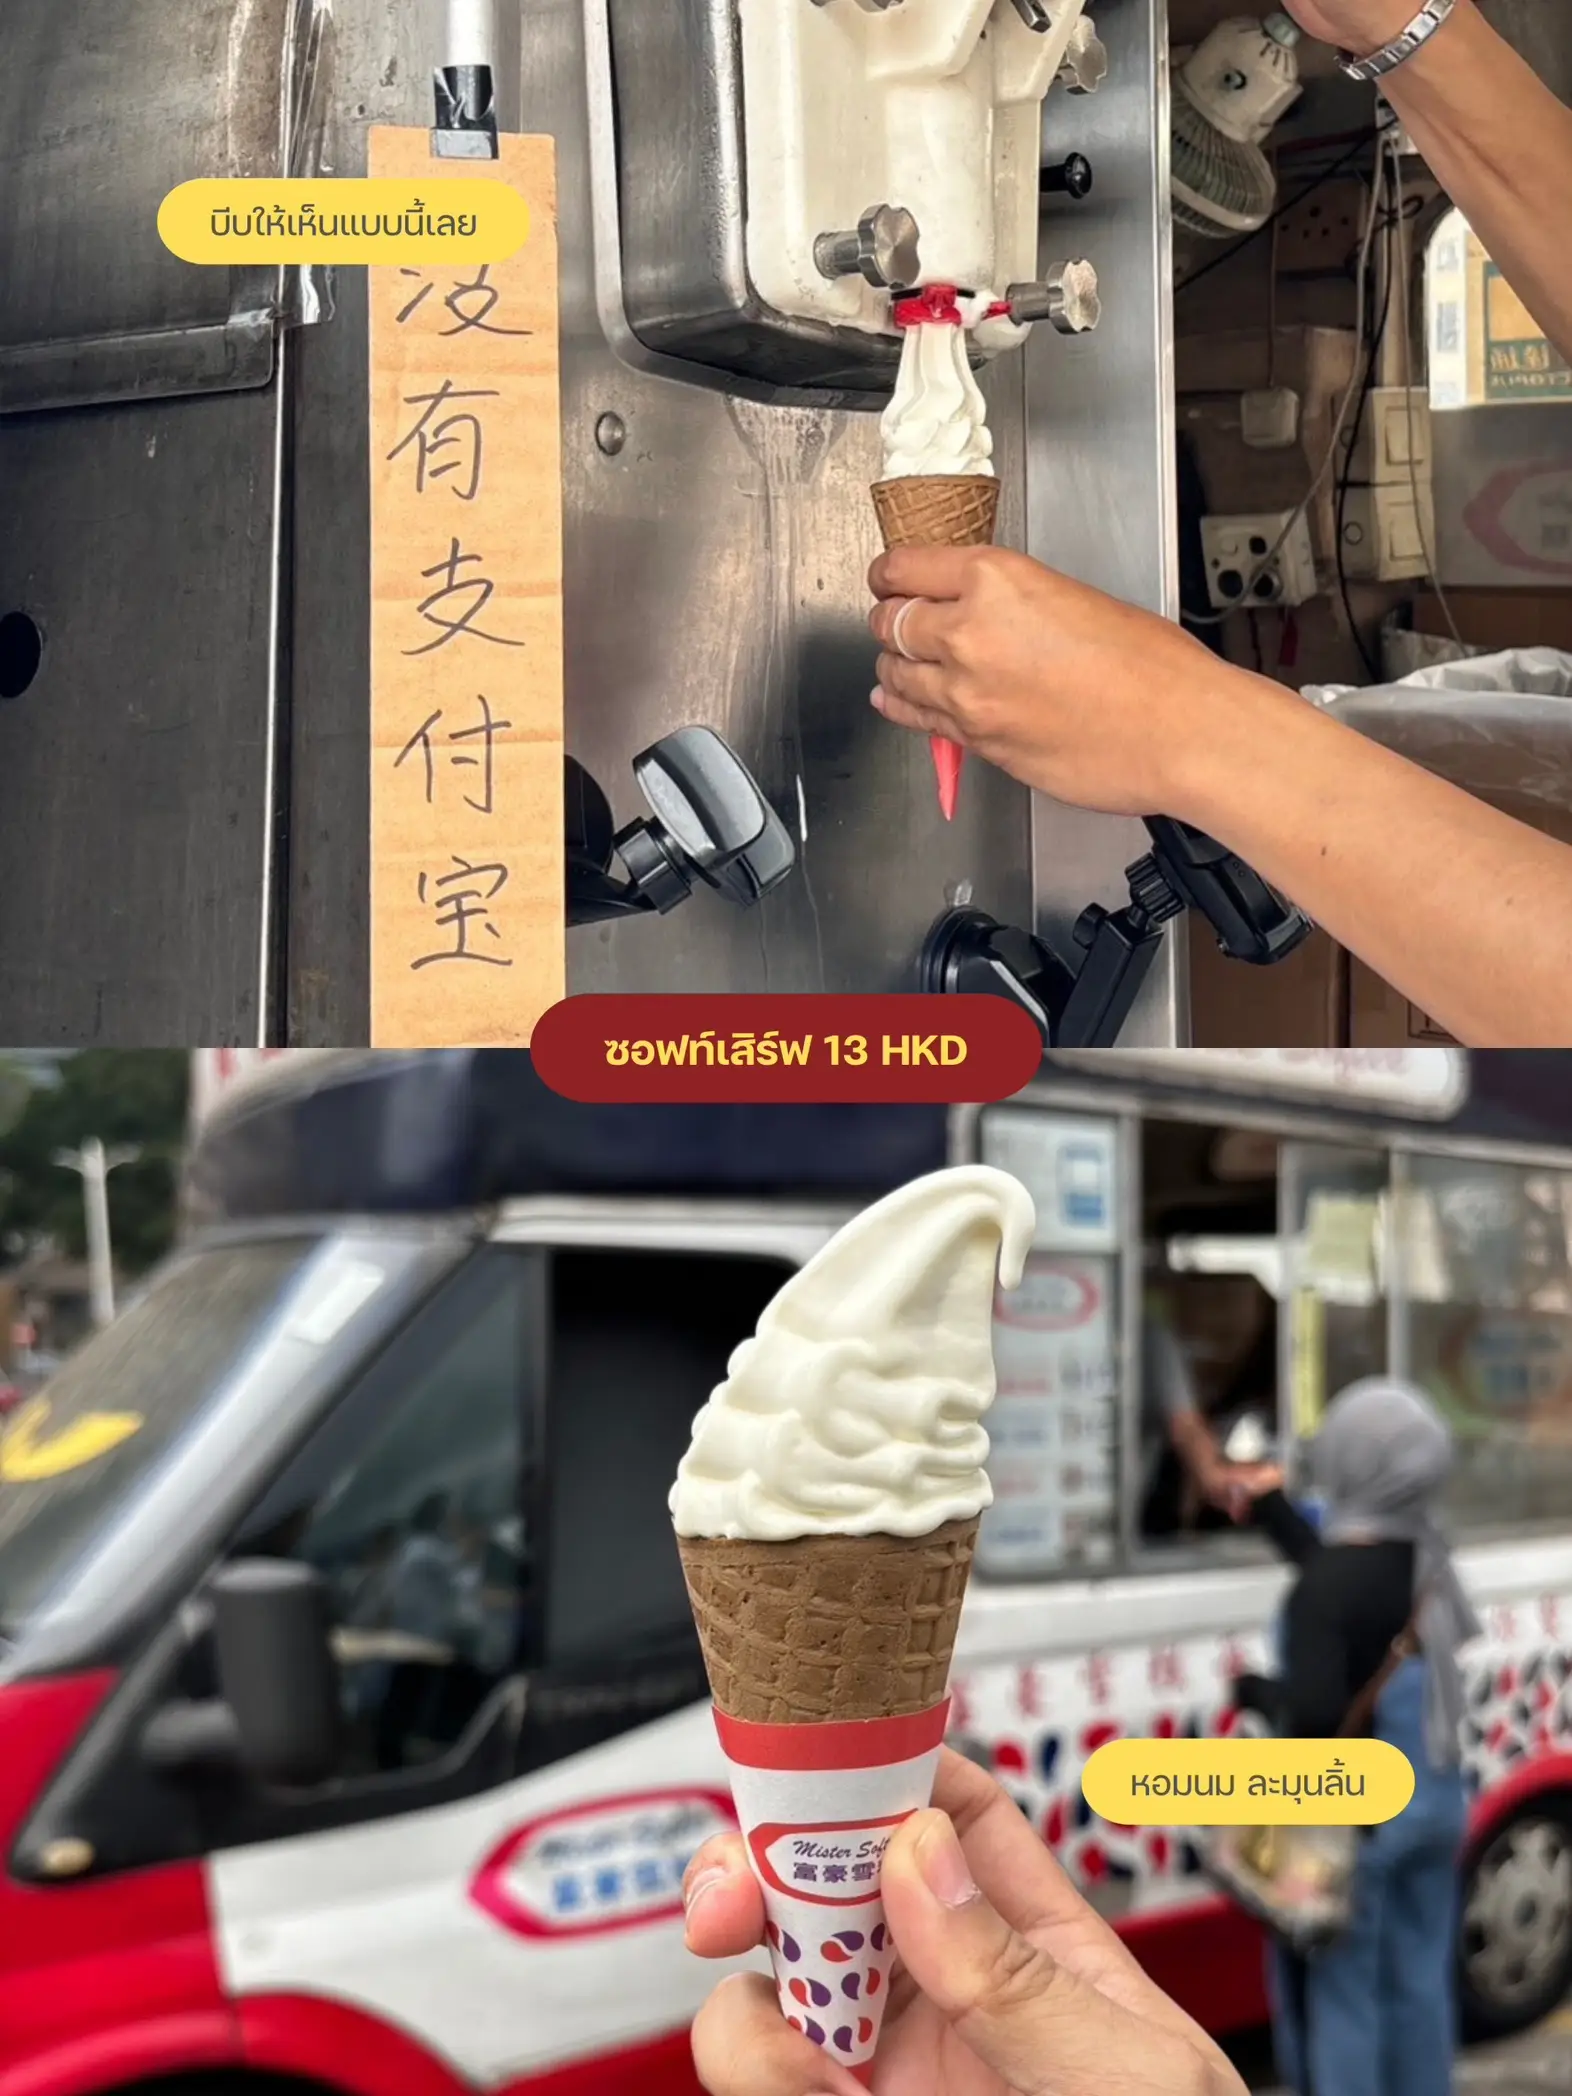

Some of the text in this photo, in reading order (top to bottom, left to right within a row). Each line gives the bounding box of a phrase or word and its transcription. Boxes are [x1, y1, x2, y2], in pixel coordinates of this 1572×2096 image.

[387, 264, 534, 970] 没有支付宝
[793, 1840, 852, 1859] Mister
[793, 1861, 883, 1883] 富豪雪
